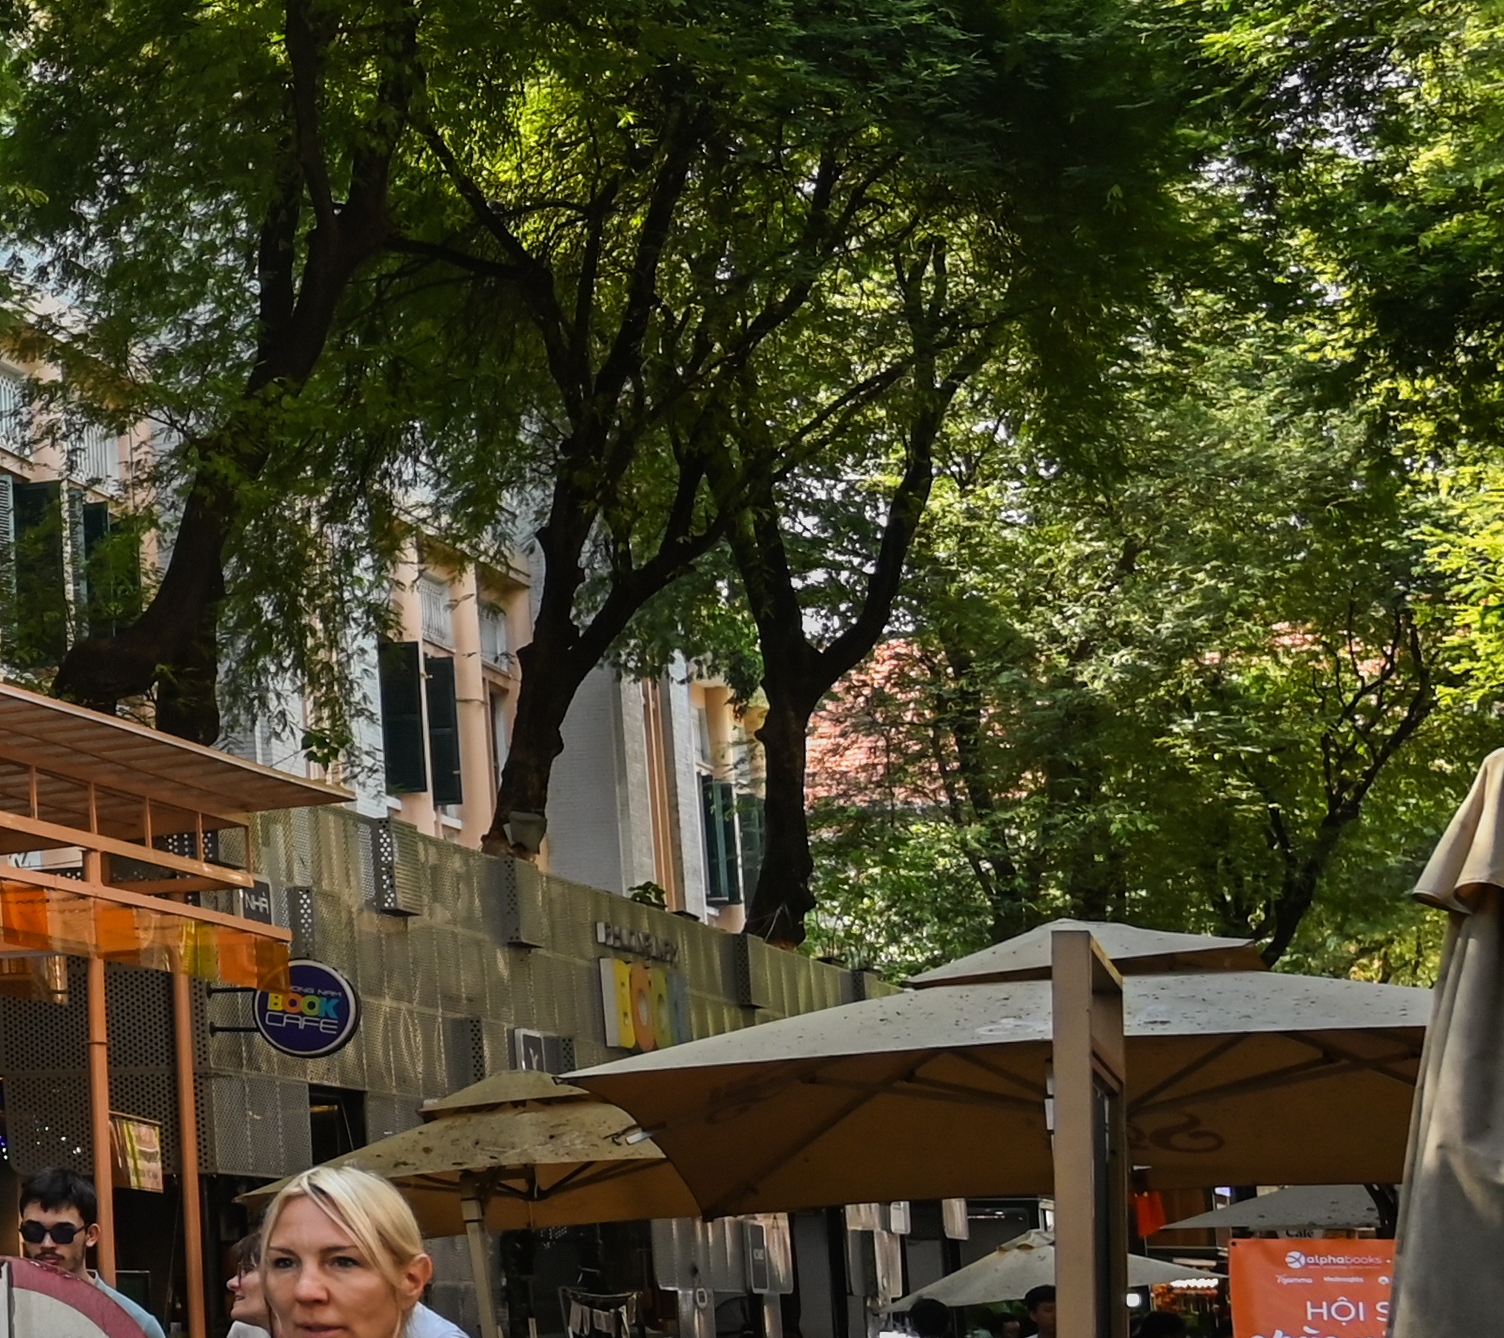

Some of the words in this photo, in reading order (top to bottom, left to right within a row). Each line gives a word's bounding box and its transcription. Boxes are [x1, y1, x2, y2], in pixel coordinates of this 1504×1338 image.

[267, 992, 340, 1019] BOOK
[265, 1012, 338, 1034] CAFE
[1306, 1295, 1365, 1327] HỘI
